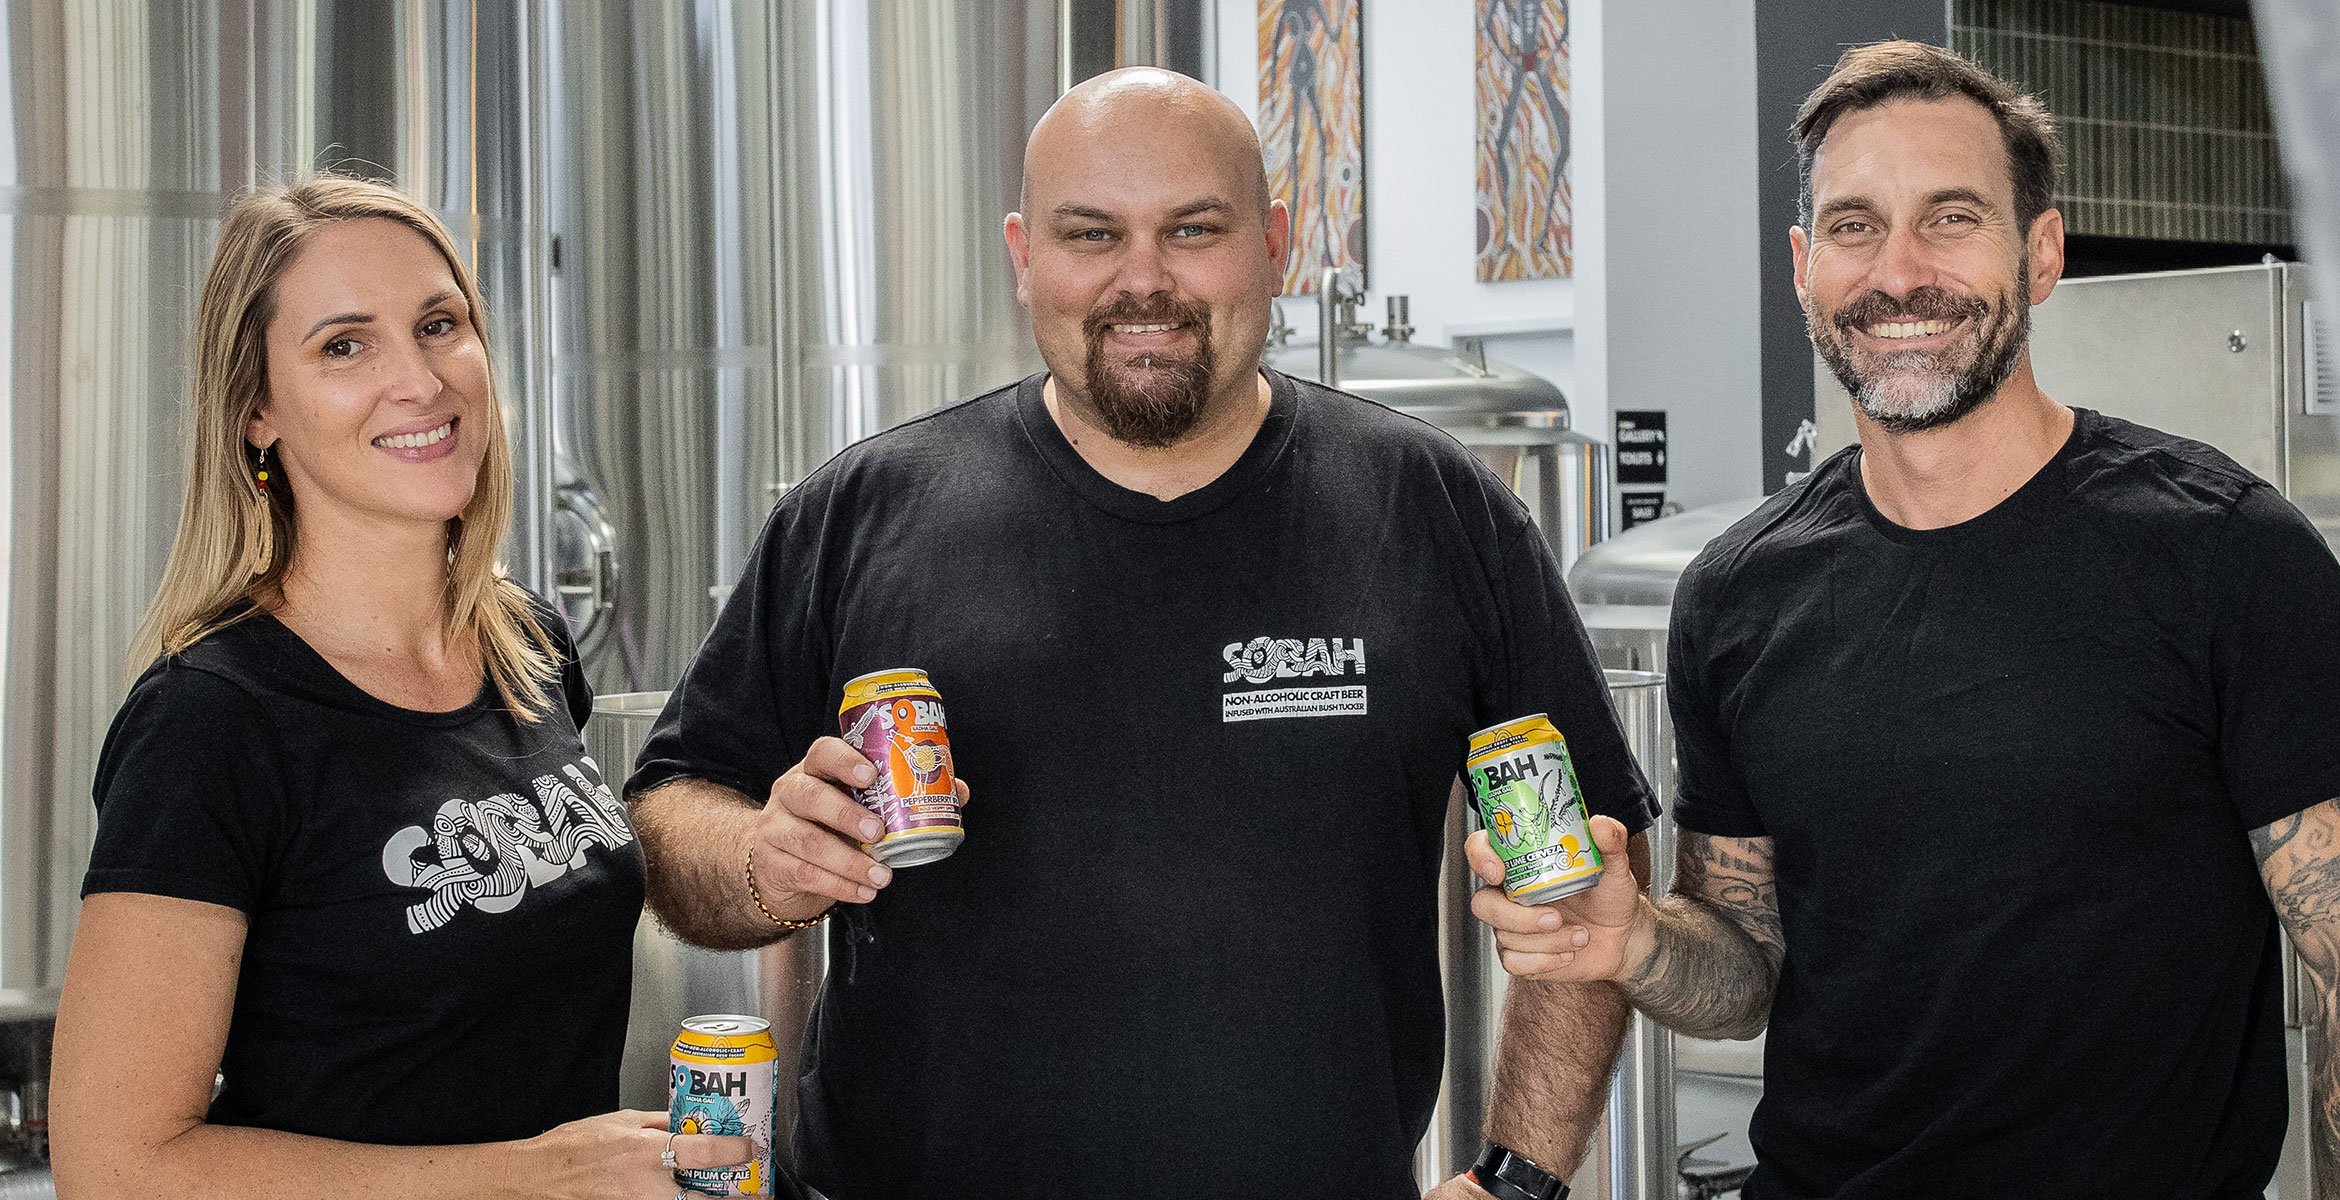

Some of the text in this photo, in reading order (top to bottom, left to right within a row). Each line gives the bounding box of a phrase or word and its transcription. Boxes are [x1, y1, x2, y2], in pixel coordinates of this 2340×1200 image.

[1223, 636, 1366, 684] SOBAH
[1225, 689, 1364, 706] NON-ALCOHOLIC CRAFT BEER
[879, 700, 948, 730] SOBAH
[1225, 702, 1365, 718] INFUSED WITH AUSTRALIAN BUSH TUCKER
[902, 795, 952, 806] PEPPERBERRY
[1511, 856, 1527, 868] LIME
[1526, 844, 1564, 862] CERVEZA
[670, 1064, 747, 1097] SOBAH
[693, 1170, 719, 1181] PLUM
[720, 1172, 734, 1181] GF
[734, 1170, 750, 1180] ALE
